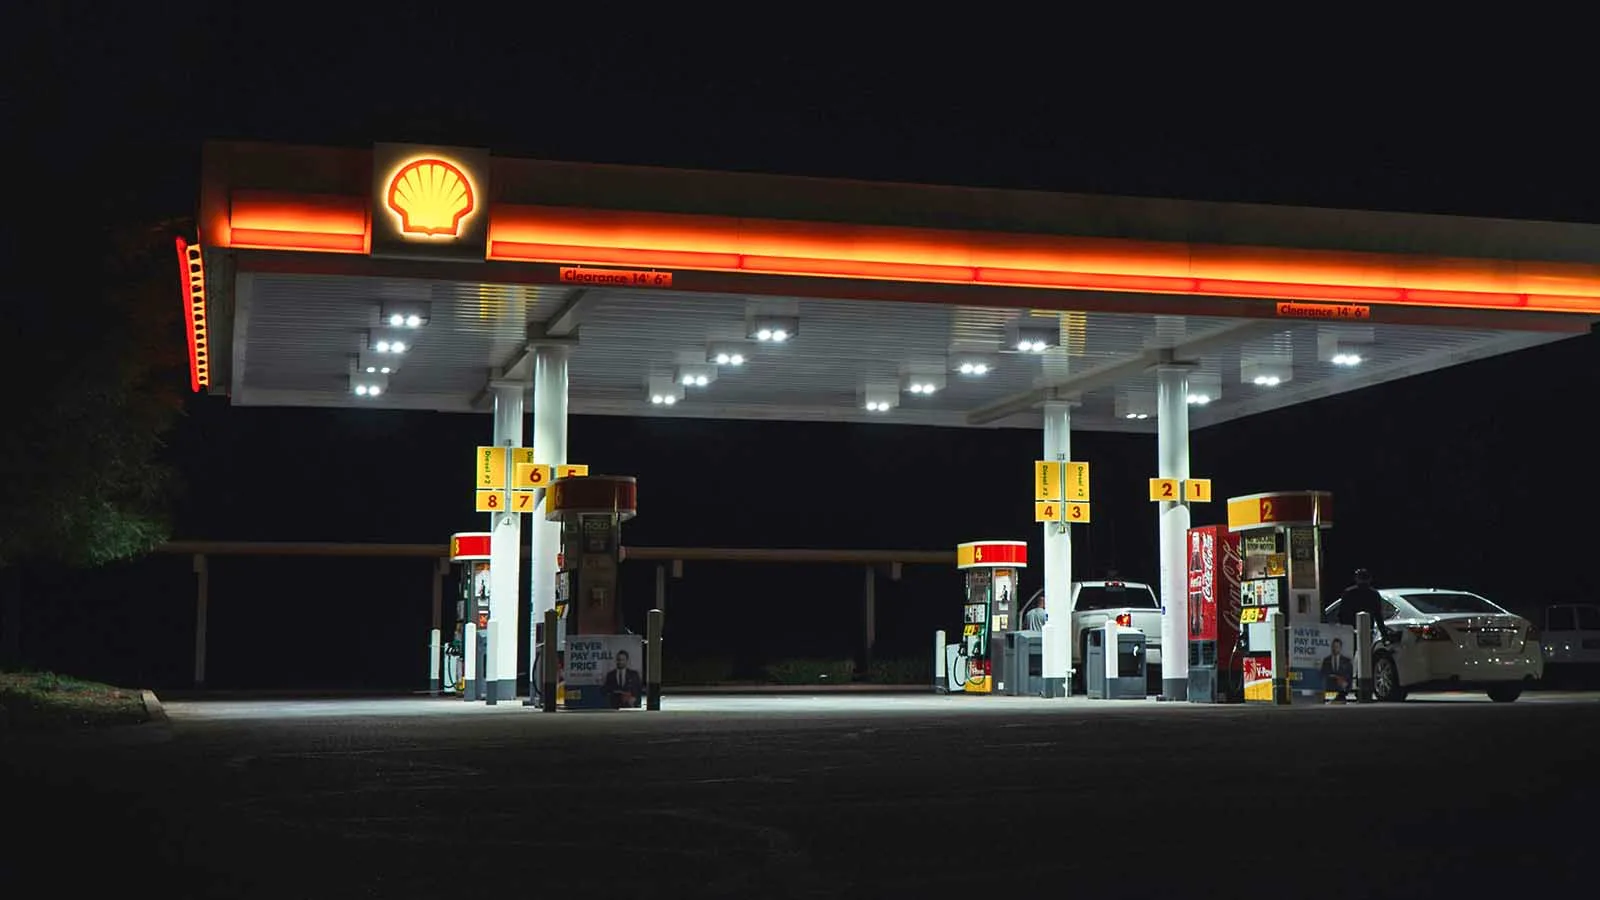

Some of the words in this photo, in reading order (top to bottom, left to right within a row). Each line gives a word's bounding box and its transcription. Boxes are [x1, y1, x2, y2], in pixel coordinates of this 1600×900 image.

[564, 269, 628, 283] Clearance
[1280, 304, 1333, 317] Clearance
[530, 468, 542, 483] 6
[1162, 482, 1173, 497] 2
[1194, 483, 1201, 497] 1
[488, 495, 497, 508] 8
[519, 495, 530, 508] 7
[1044, 505, 1053, 517] 4
[1072, 506, 1081, 518] 3
[1262, 502, 1273, 520] 2
[975, 547, 983, 561] 4
[1293, 629, 1320, 637] NEVER
[571, 641, 602, 650] NEVER
[1294, 638, 1309, 646] PAY
[1311, 638, 1330, 647] FULL
[571, 651, 588, 660] PAY
[591, 651, 614, 660] FULL
[1294, 646, 1316, 655] PRICE
[571, 661, 597, 670] PRICE
